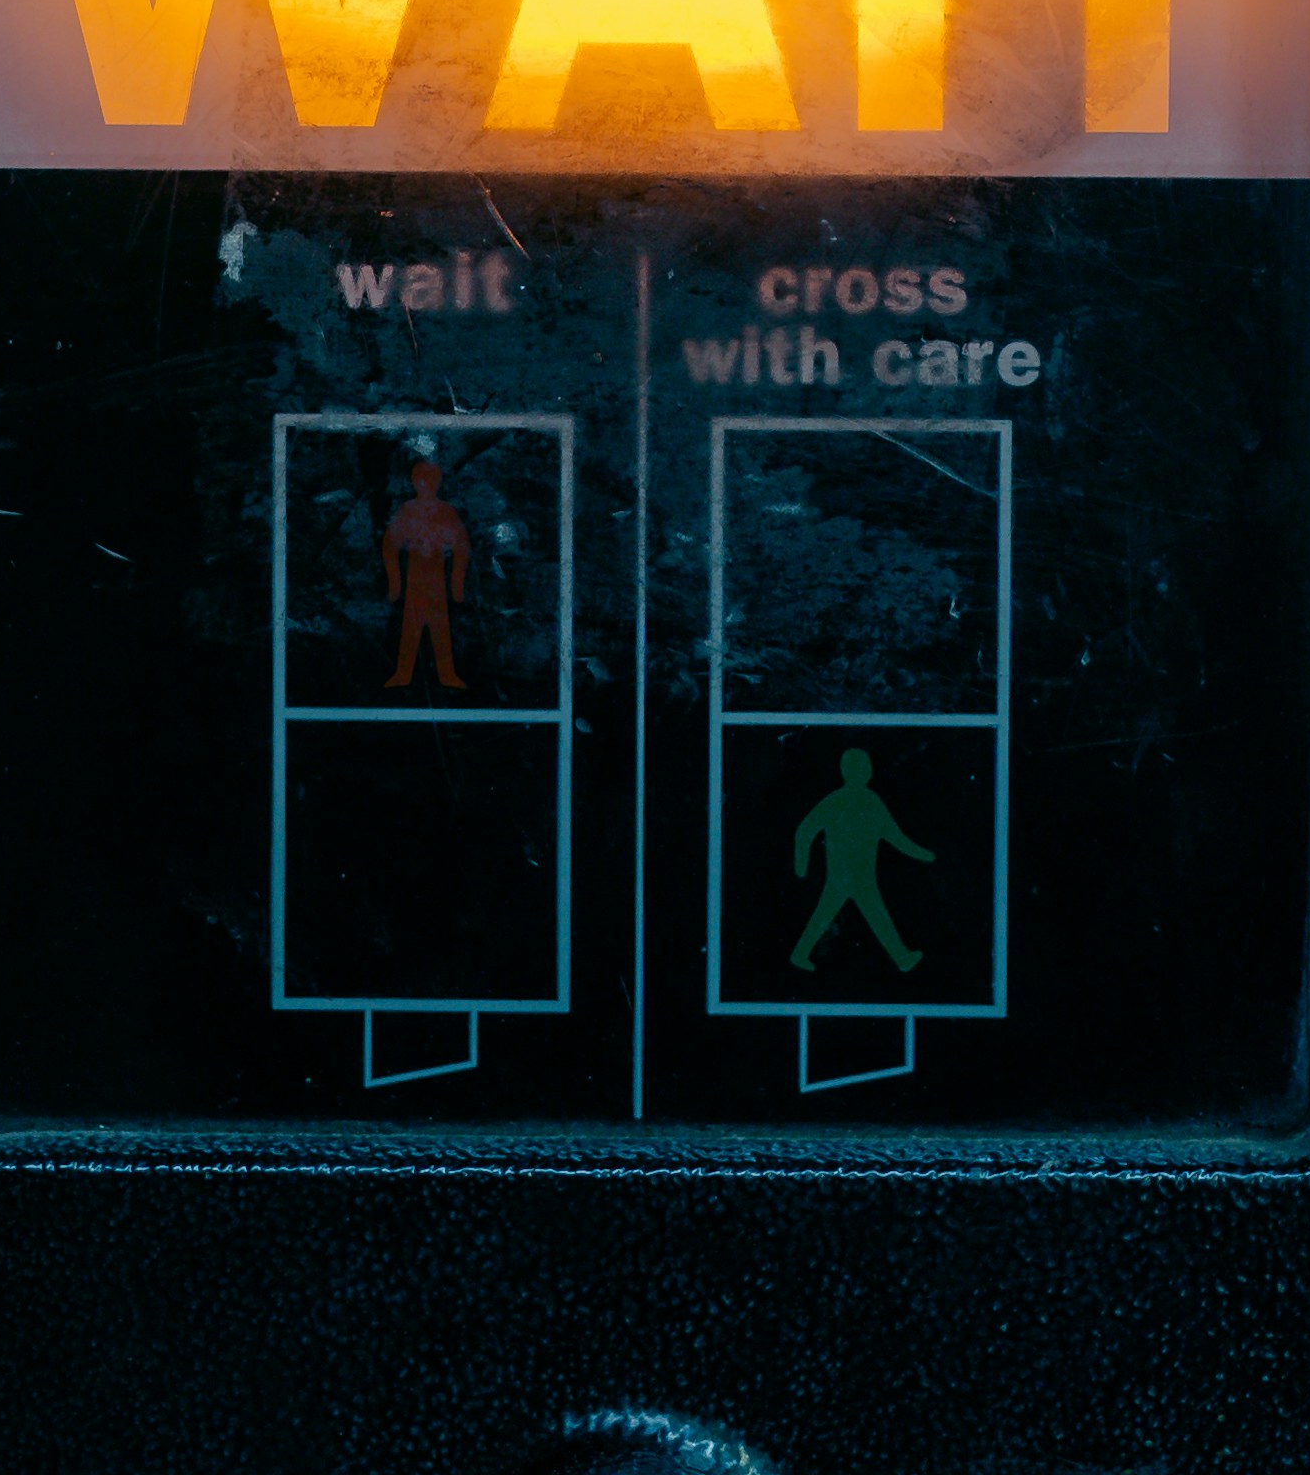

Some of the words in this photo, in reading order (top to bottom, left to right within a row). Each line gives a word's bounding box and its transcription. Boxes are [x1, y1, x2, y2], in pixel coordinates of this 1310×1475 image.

[336, 249, 514, 312] wait
[757, 264, 968, 316] cross
[682, 325, 840, 386] with
[871, 337, 1041, 388] care
